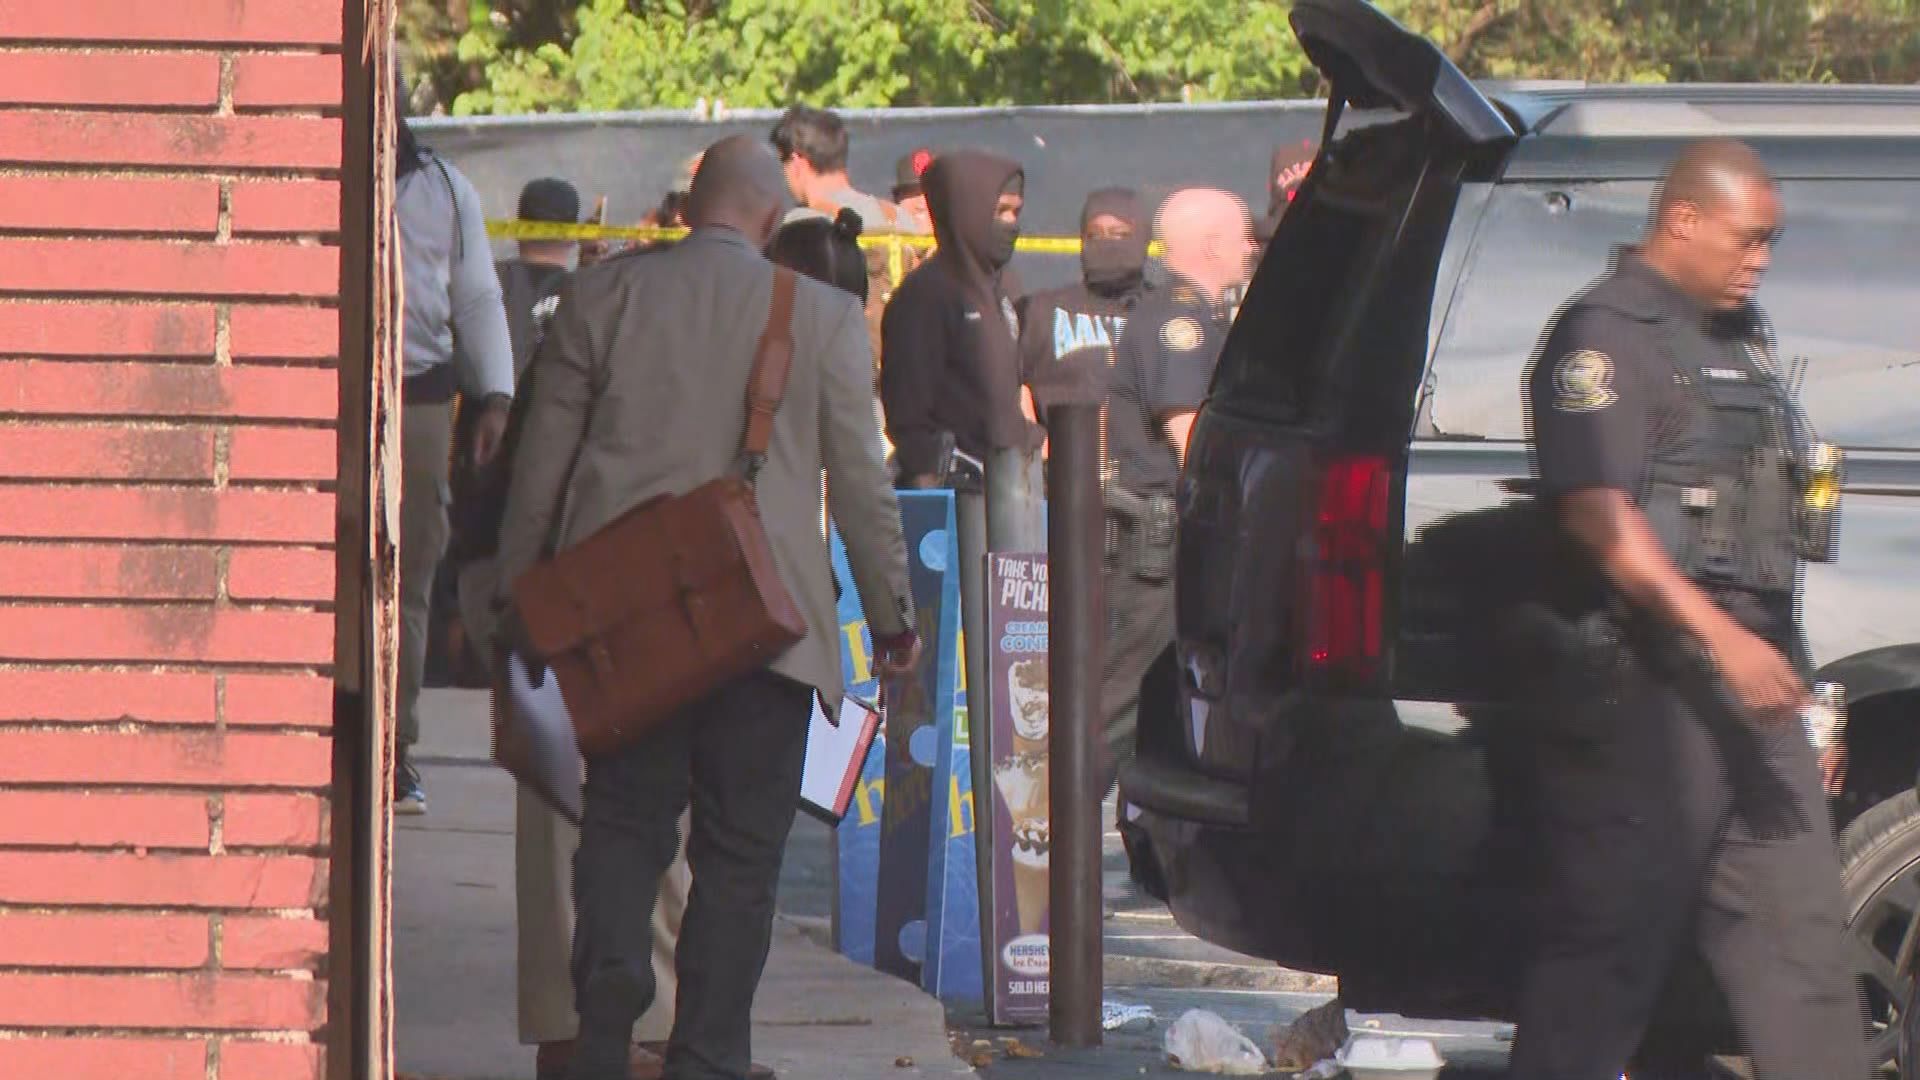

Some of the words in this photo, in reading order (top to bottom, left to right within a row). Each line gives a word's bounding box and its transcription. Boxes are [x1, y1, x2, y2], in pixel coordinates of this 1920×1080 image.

[997, 557, 1029, 580] TAKE
[1032, 556, 1048, 582] YO
[1027, 956, 1048, 968] Crea
[1008, 981, 1033, 994] SOLD
[1034, 981, 1049, 994] HE
